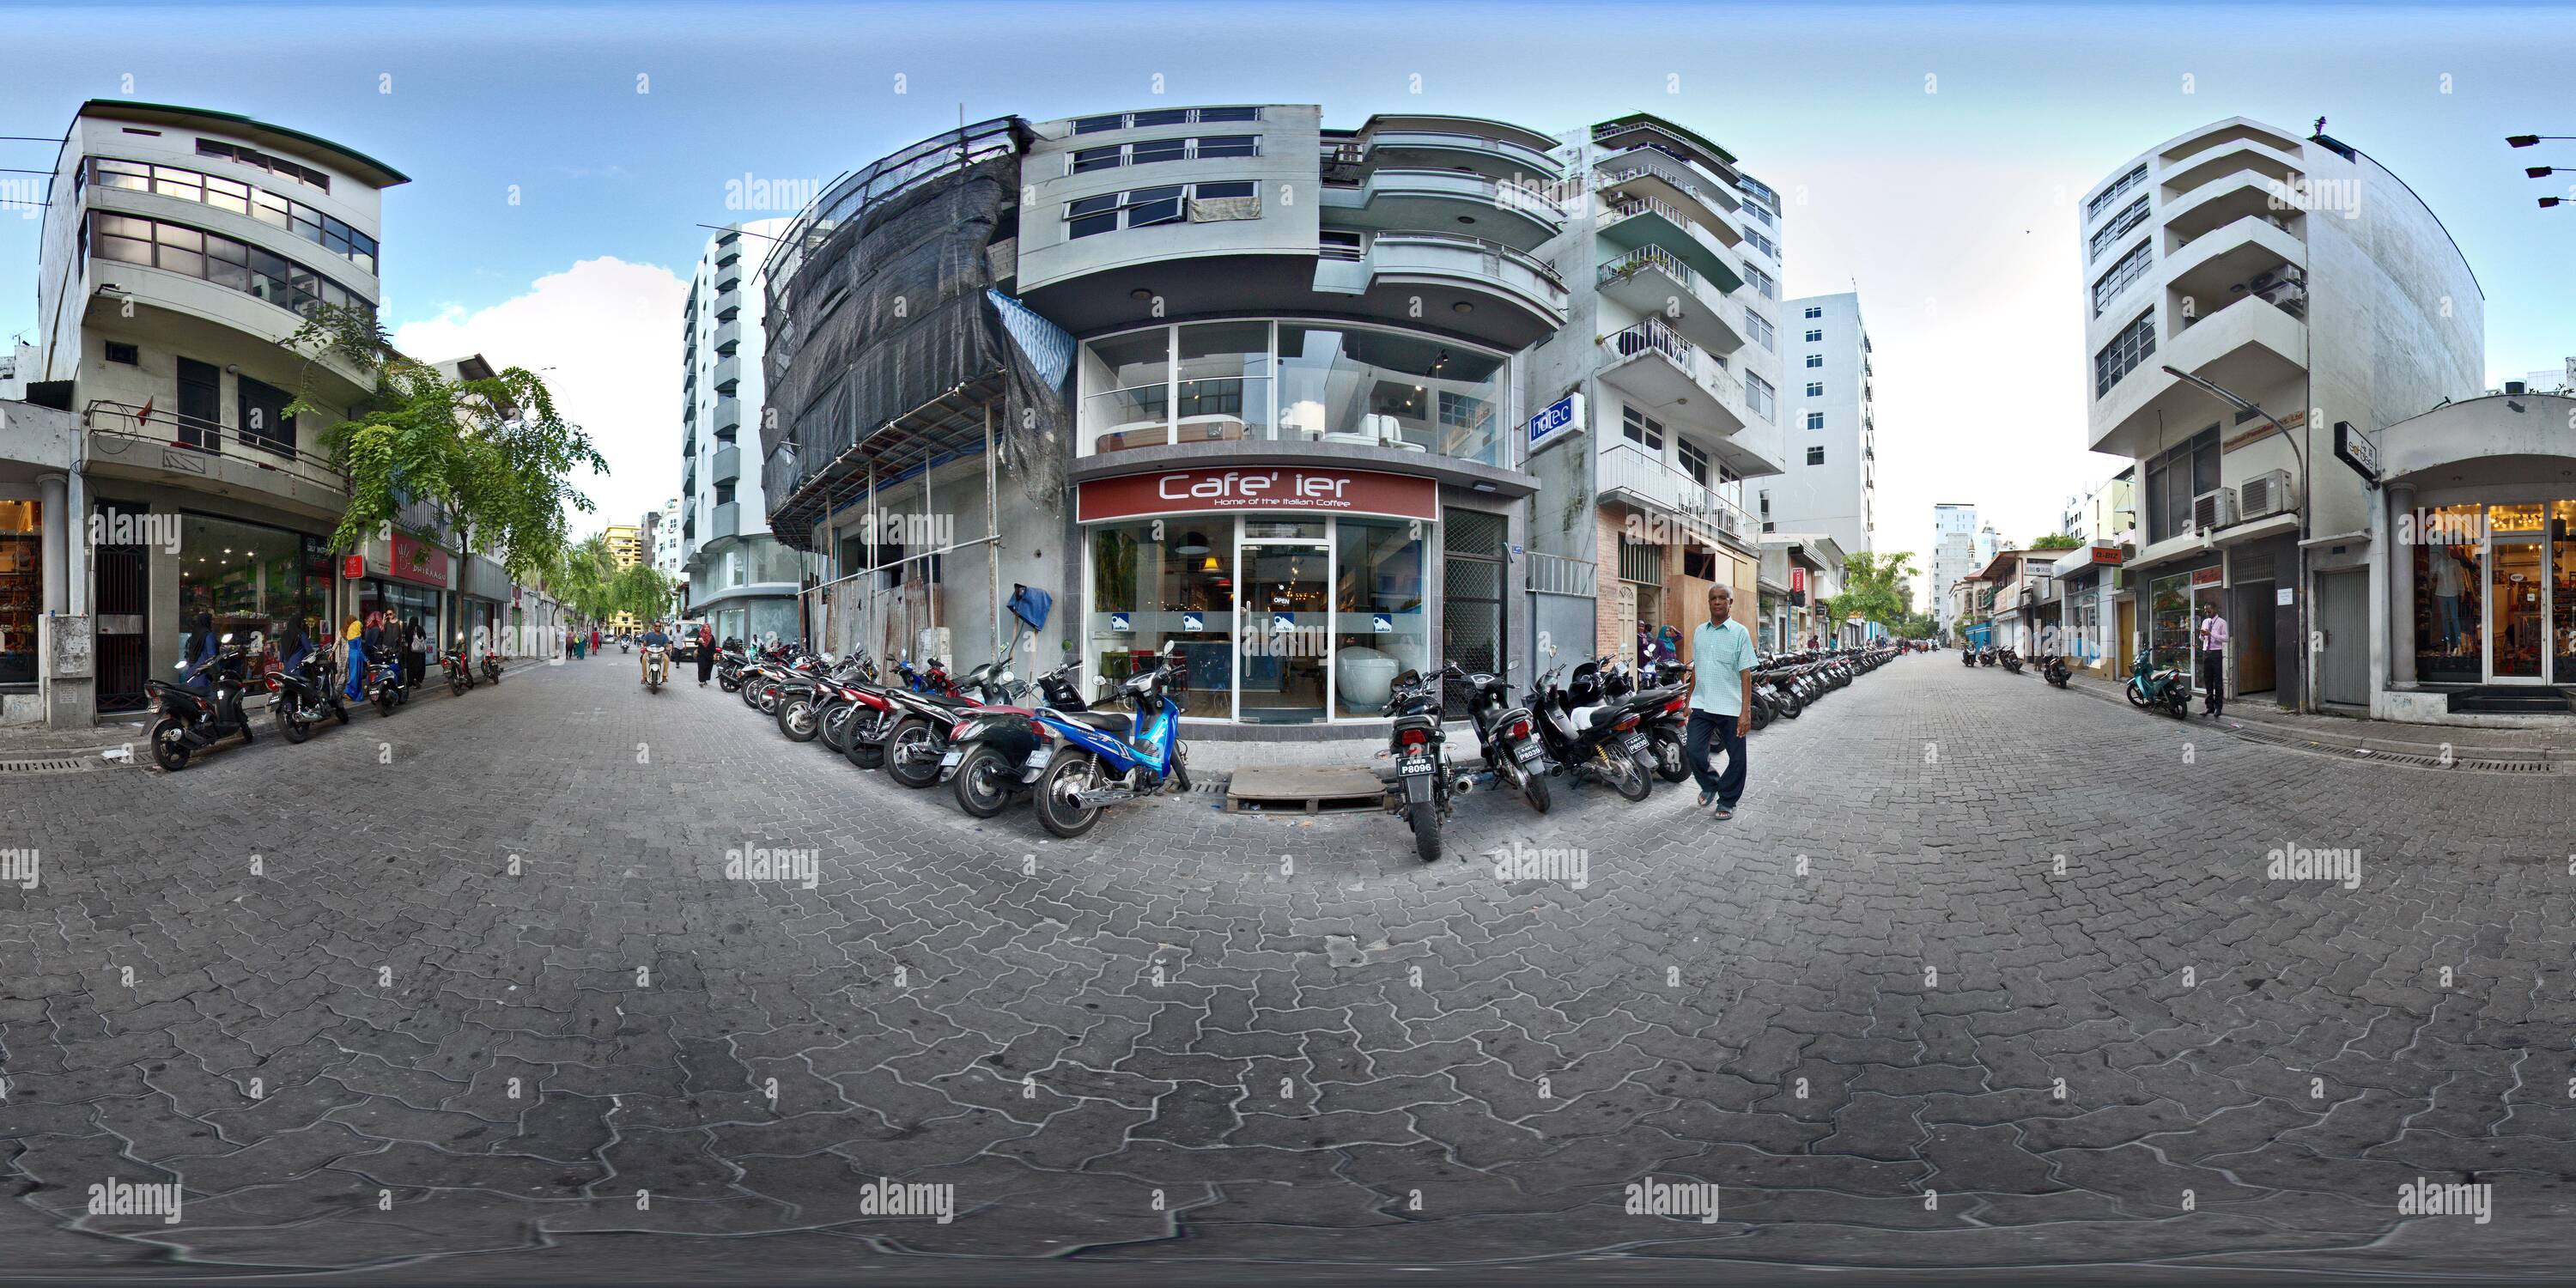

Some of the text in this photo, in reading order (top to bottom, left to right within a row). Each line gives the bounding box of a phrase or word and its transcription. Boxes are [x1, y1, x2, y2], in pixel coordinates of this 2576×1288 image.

[1296, 473, 1350, 497] ier
[1316, 499, 1351, 507] Coffee
[1520, 748, 1540, 761] P8039
[1401, 763, 1431, 774] P8096
